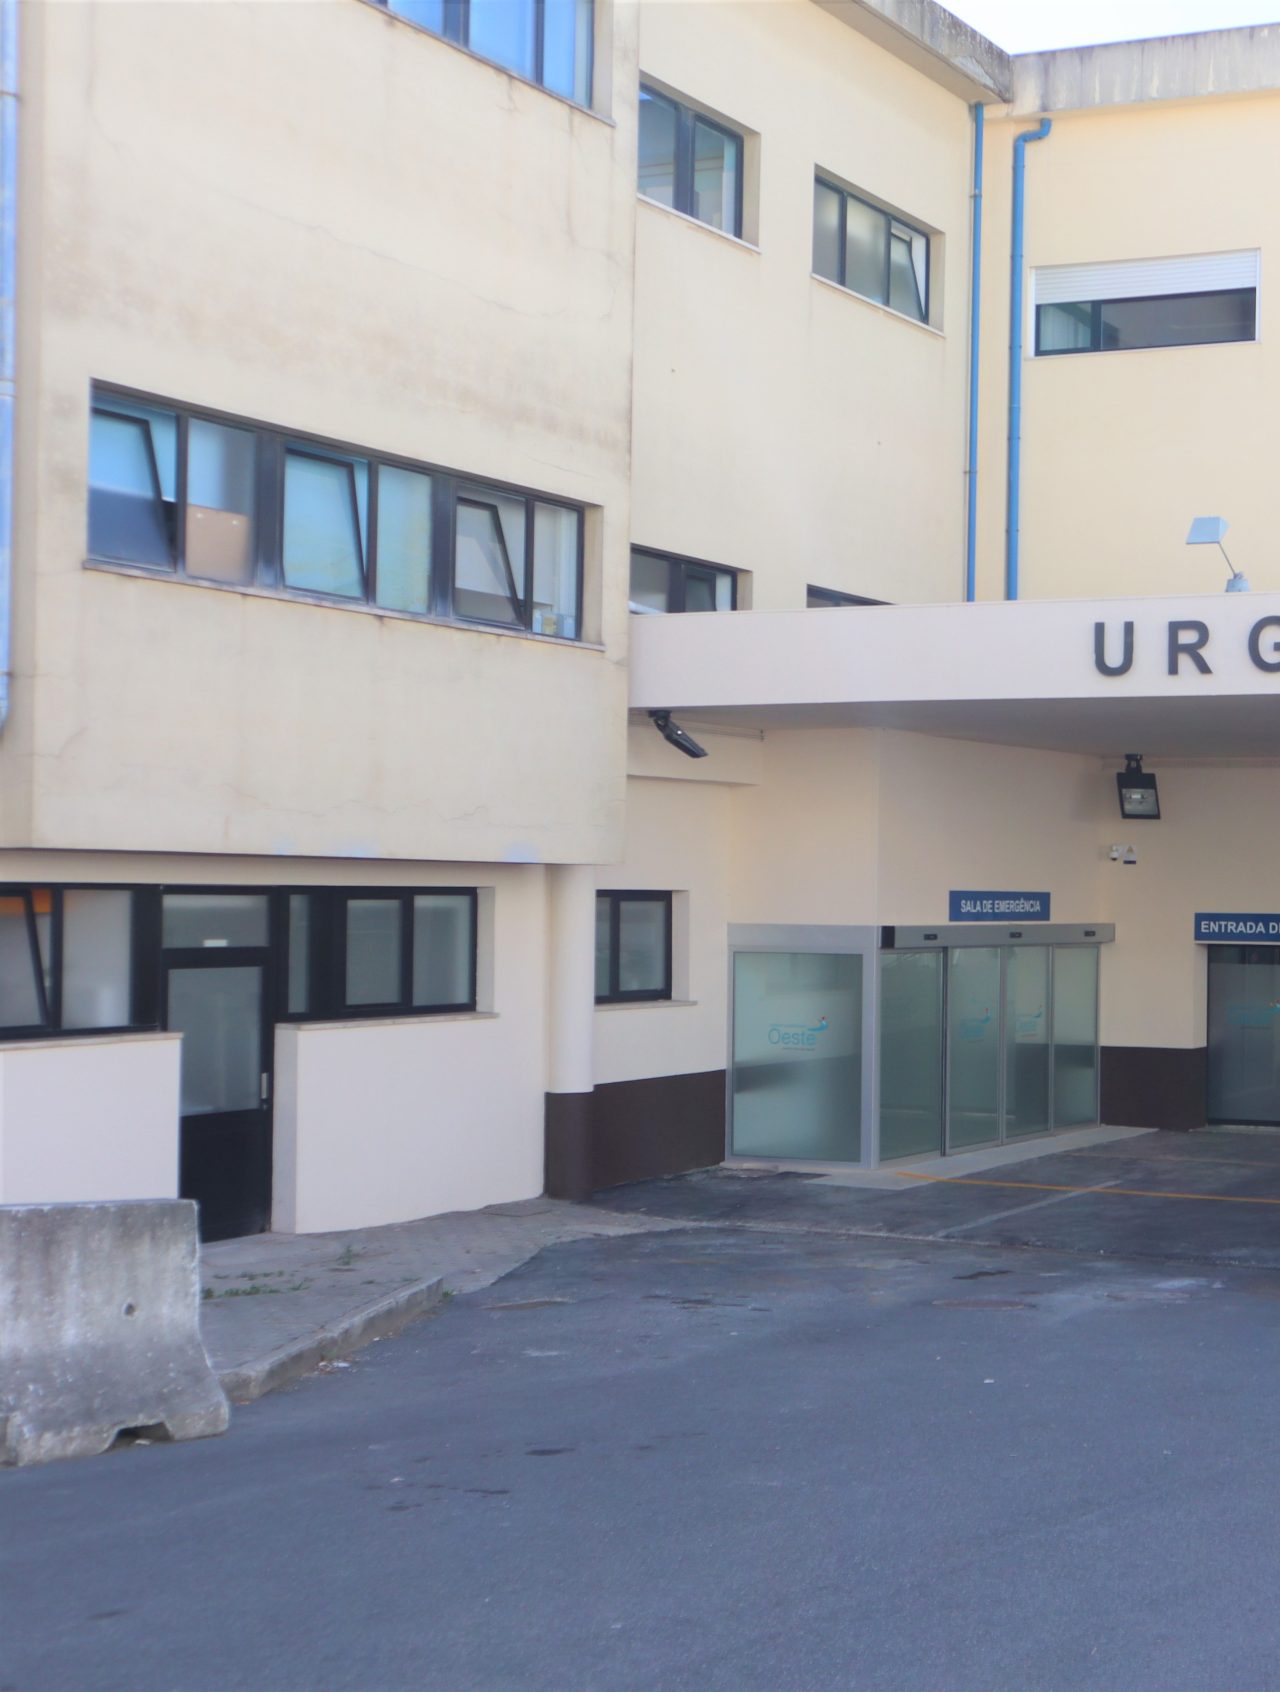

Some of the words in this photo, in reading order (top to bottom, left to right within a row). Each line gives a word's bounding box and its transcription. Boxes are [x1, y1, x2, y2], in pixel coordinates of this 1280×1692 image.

[960, 899, 981, 913] SALA
[982, 900, 993, 913] DE
[994, 897, 1041, 913] EMERGÊNCIA
[1200, 920, 1266, 934] ENTRADA
[767, 1027, 817, 1047] Oeste
